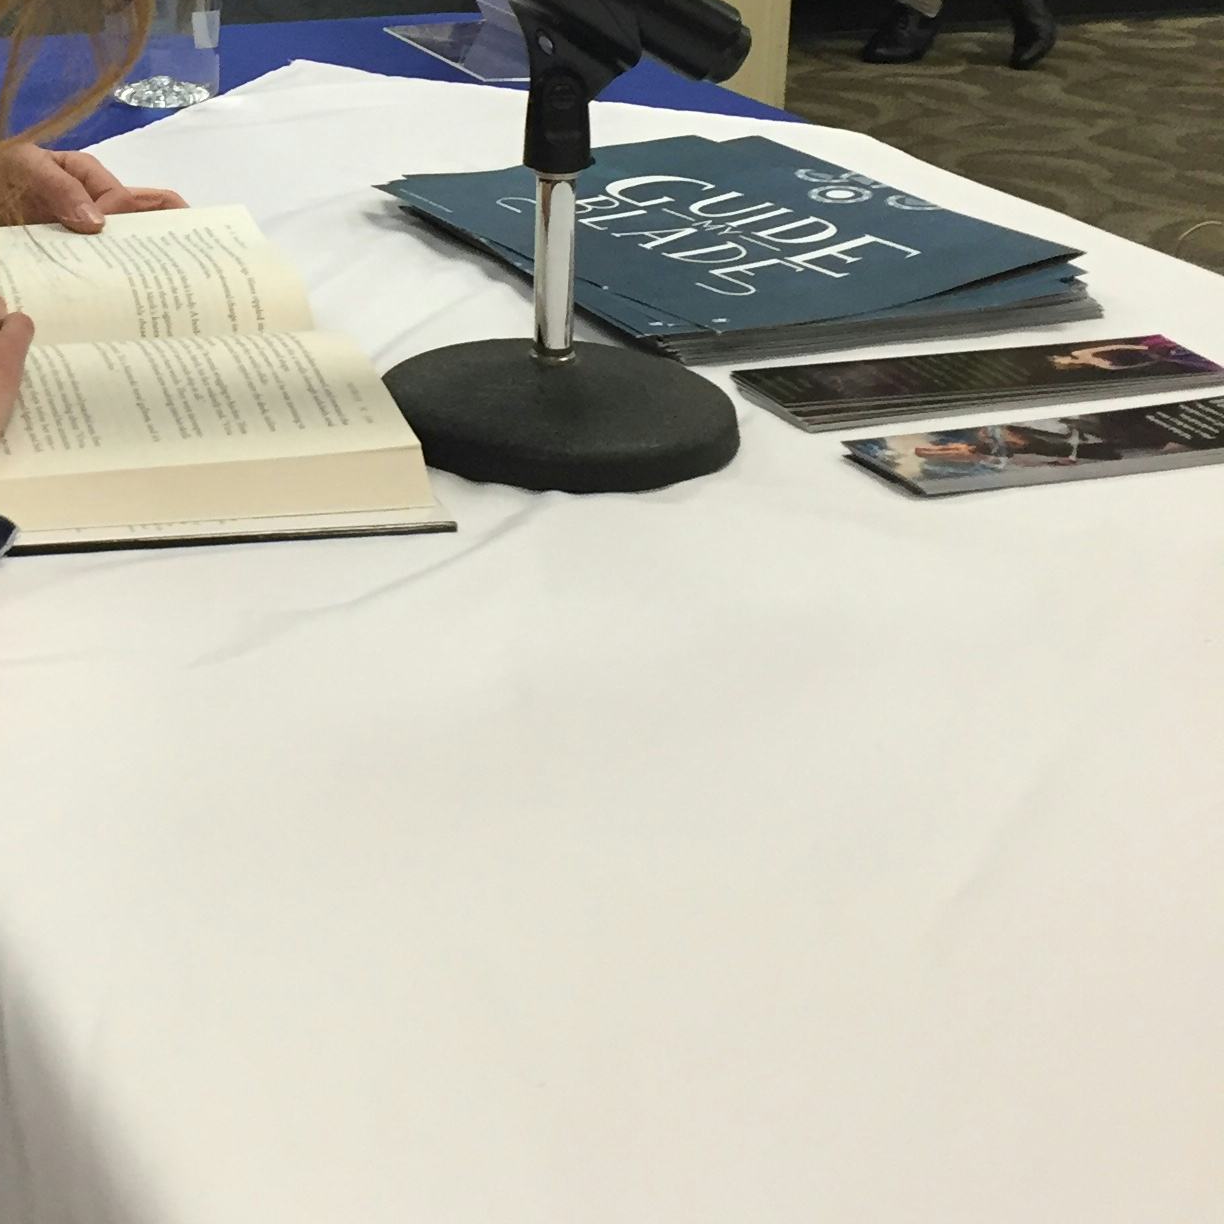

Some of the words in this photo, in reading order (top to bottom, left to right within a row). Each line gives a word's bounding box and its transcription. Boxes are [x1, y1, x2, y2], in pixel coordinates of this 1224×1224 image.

[575, 193, 805, 296] BLADE
[605, 175, 921, 279] GUIDE
[691, 218, 743, 237] MY
